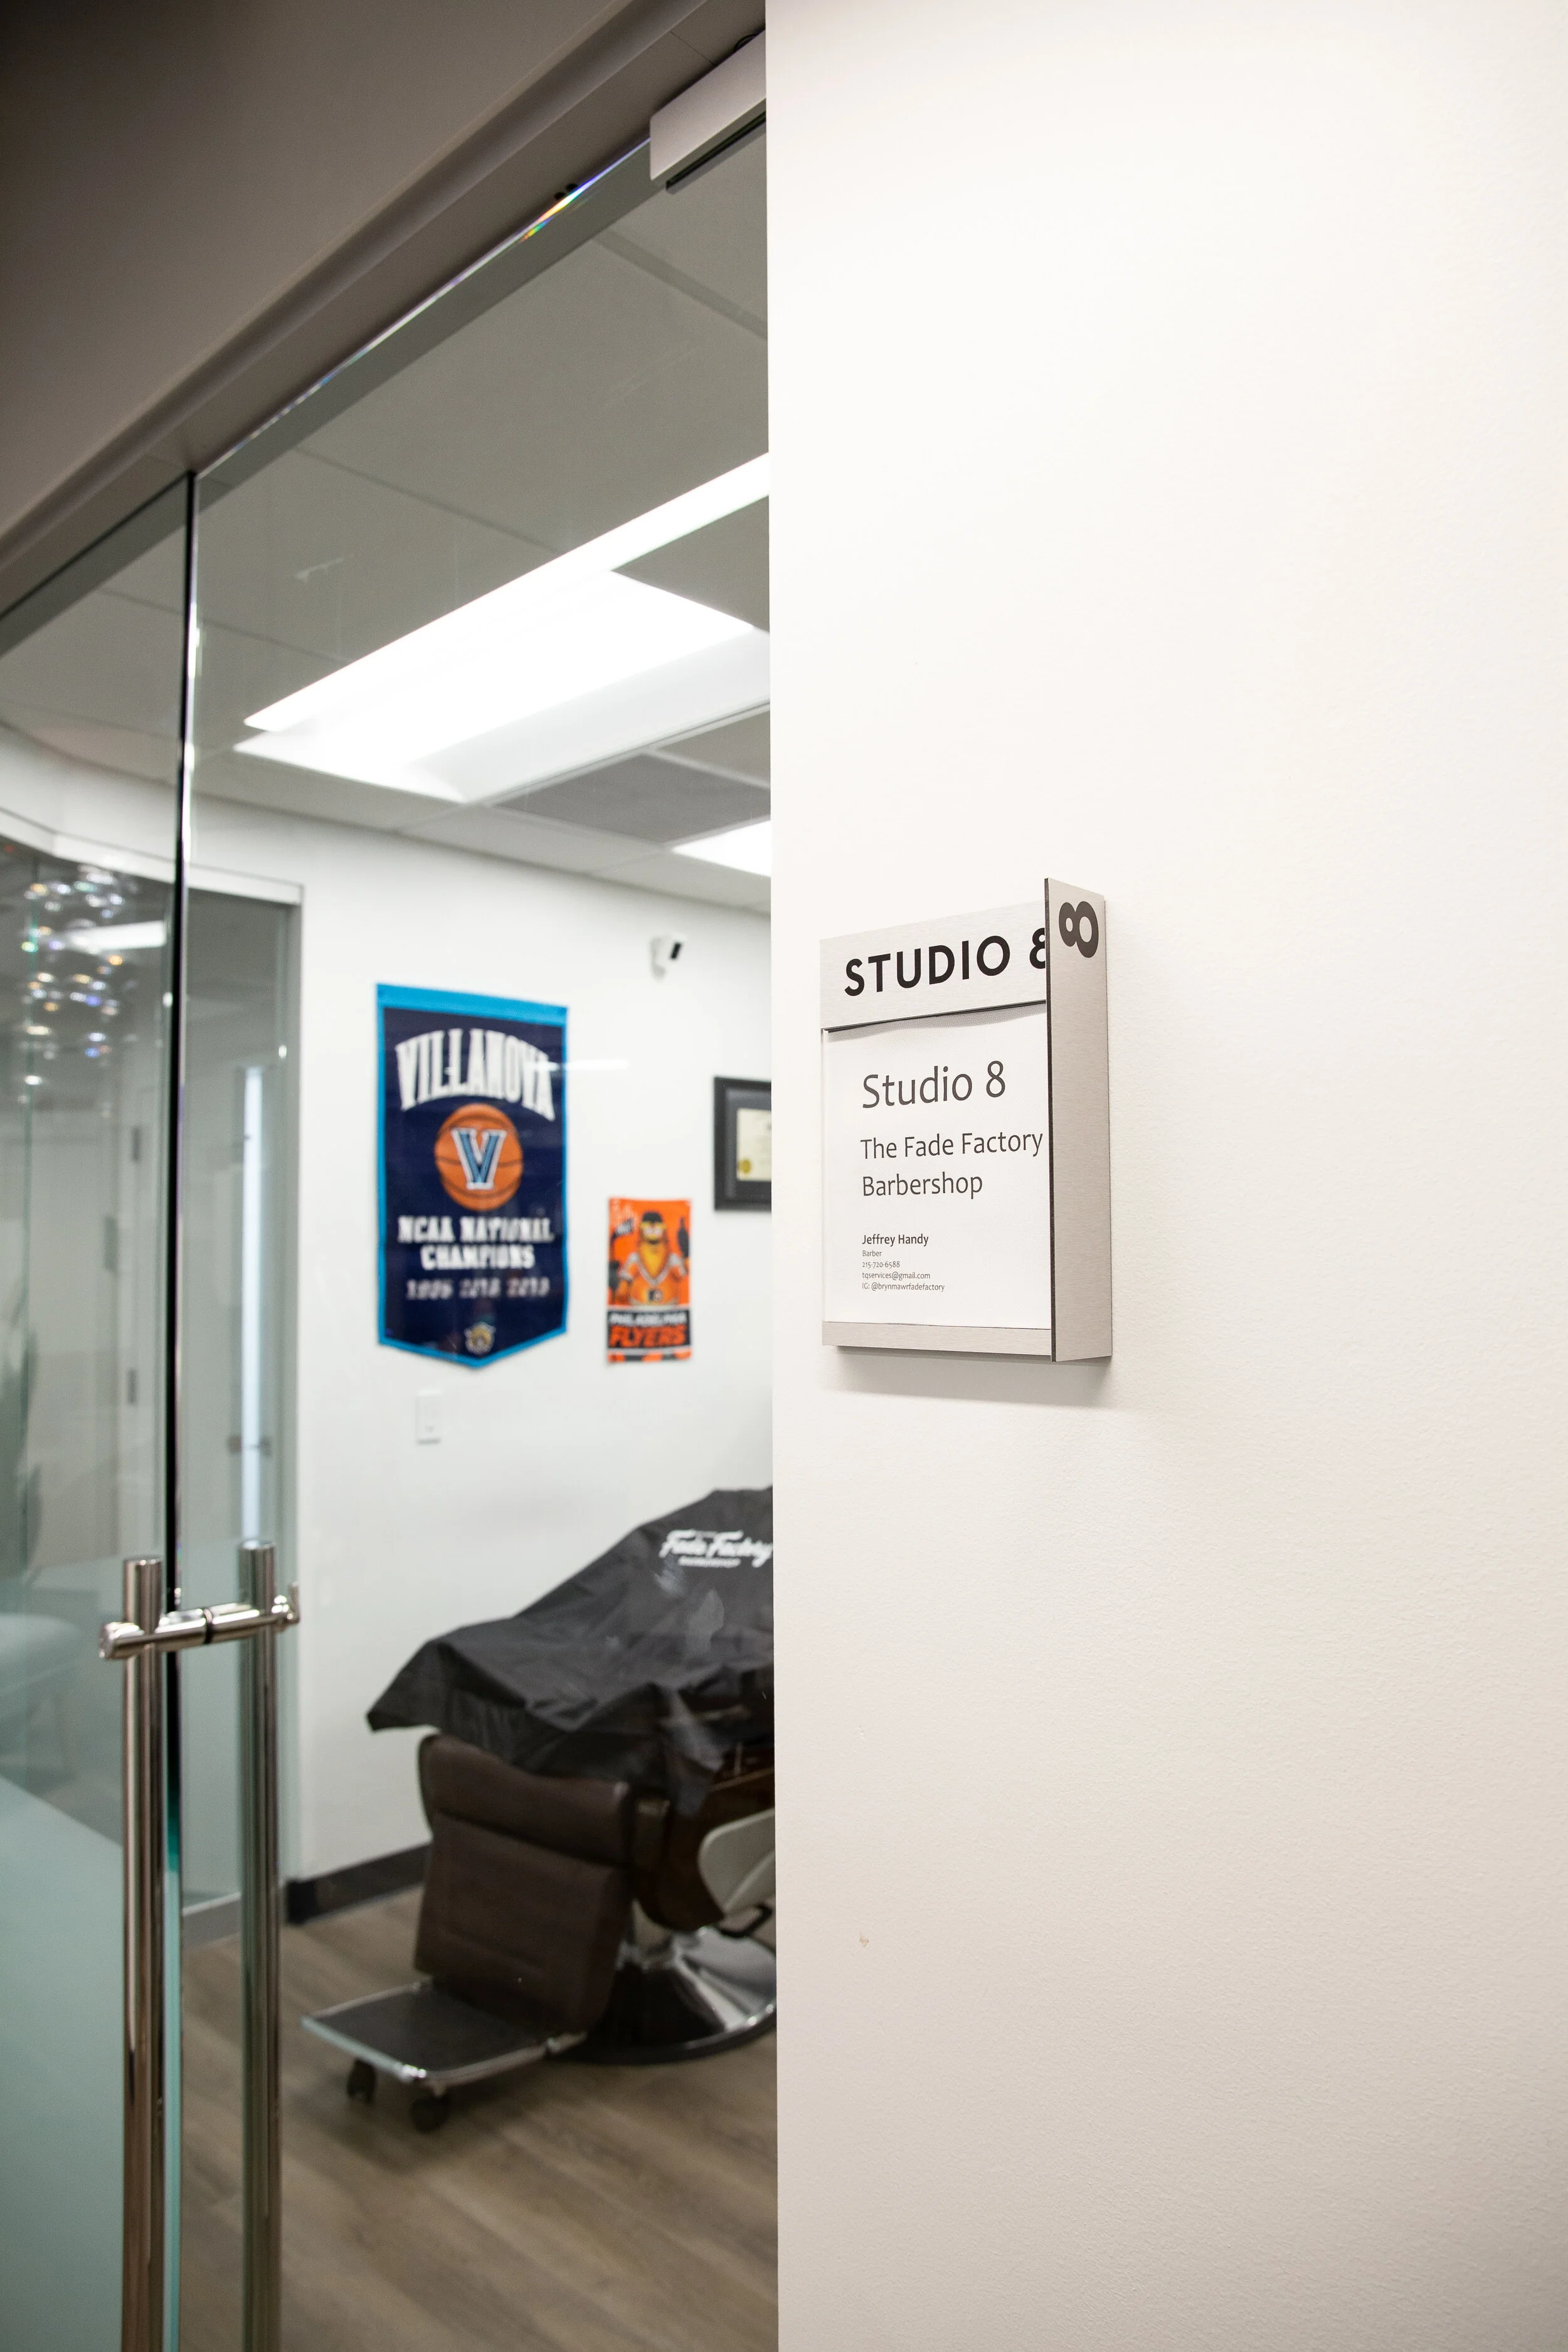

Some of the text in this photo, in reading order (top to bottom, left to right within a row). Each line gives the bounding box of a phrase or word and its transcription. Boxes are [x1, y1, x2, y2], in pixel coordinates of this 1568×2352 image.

[1058, 901, 1099, 958] 8
[844, 927, 1046, 997] STUDIO 8
[396, 1027, 556, 1122] VILLANOVA
[862, 1060, 1006, 1109] Studio 8
[450, 1128, 506, 1189] V
[861, 1131, 1043, 1160] The Fade Factory
[862, 1171, 983, 1200] Barbershop
[398, 1216, 555, 1244] NCAA NATIONAL
[862, 1233, 929, 1247] Jeffrey Handy
[420, 1244, 535, 1270] CHAMPIONS
[862, 1261, 900, 1269] 215-720-6588
[862, 1271, 931, 1281] tqservices@gmail.com
[871, 1282, 945, 1292] @brynmawrfadefactory
